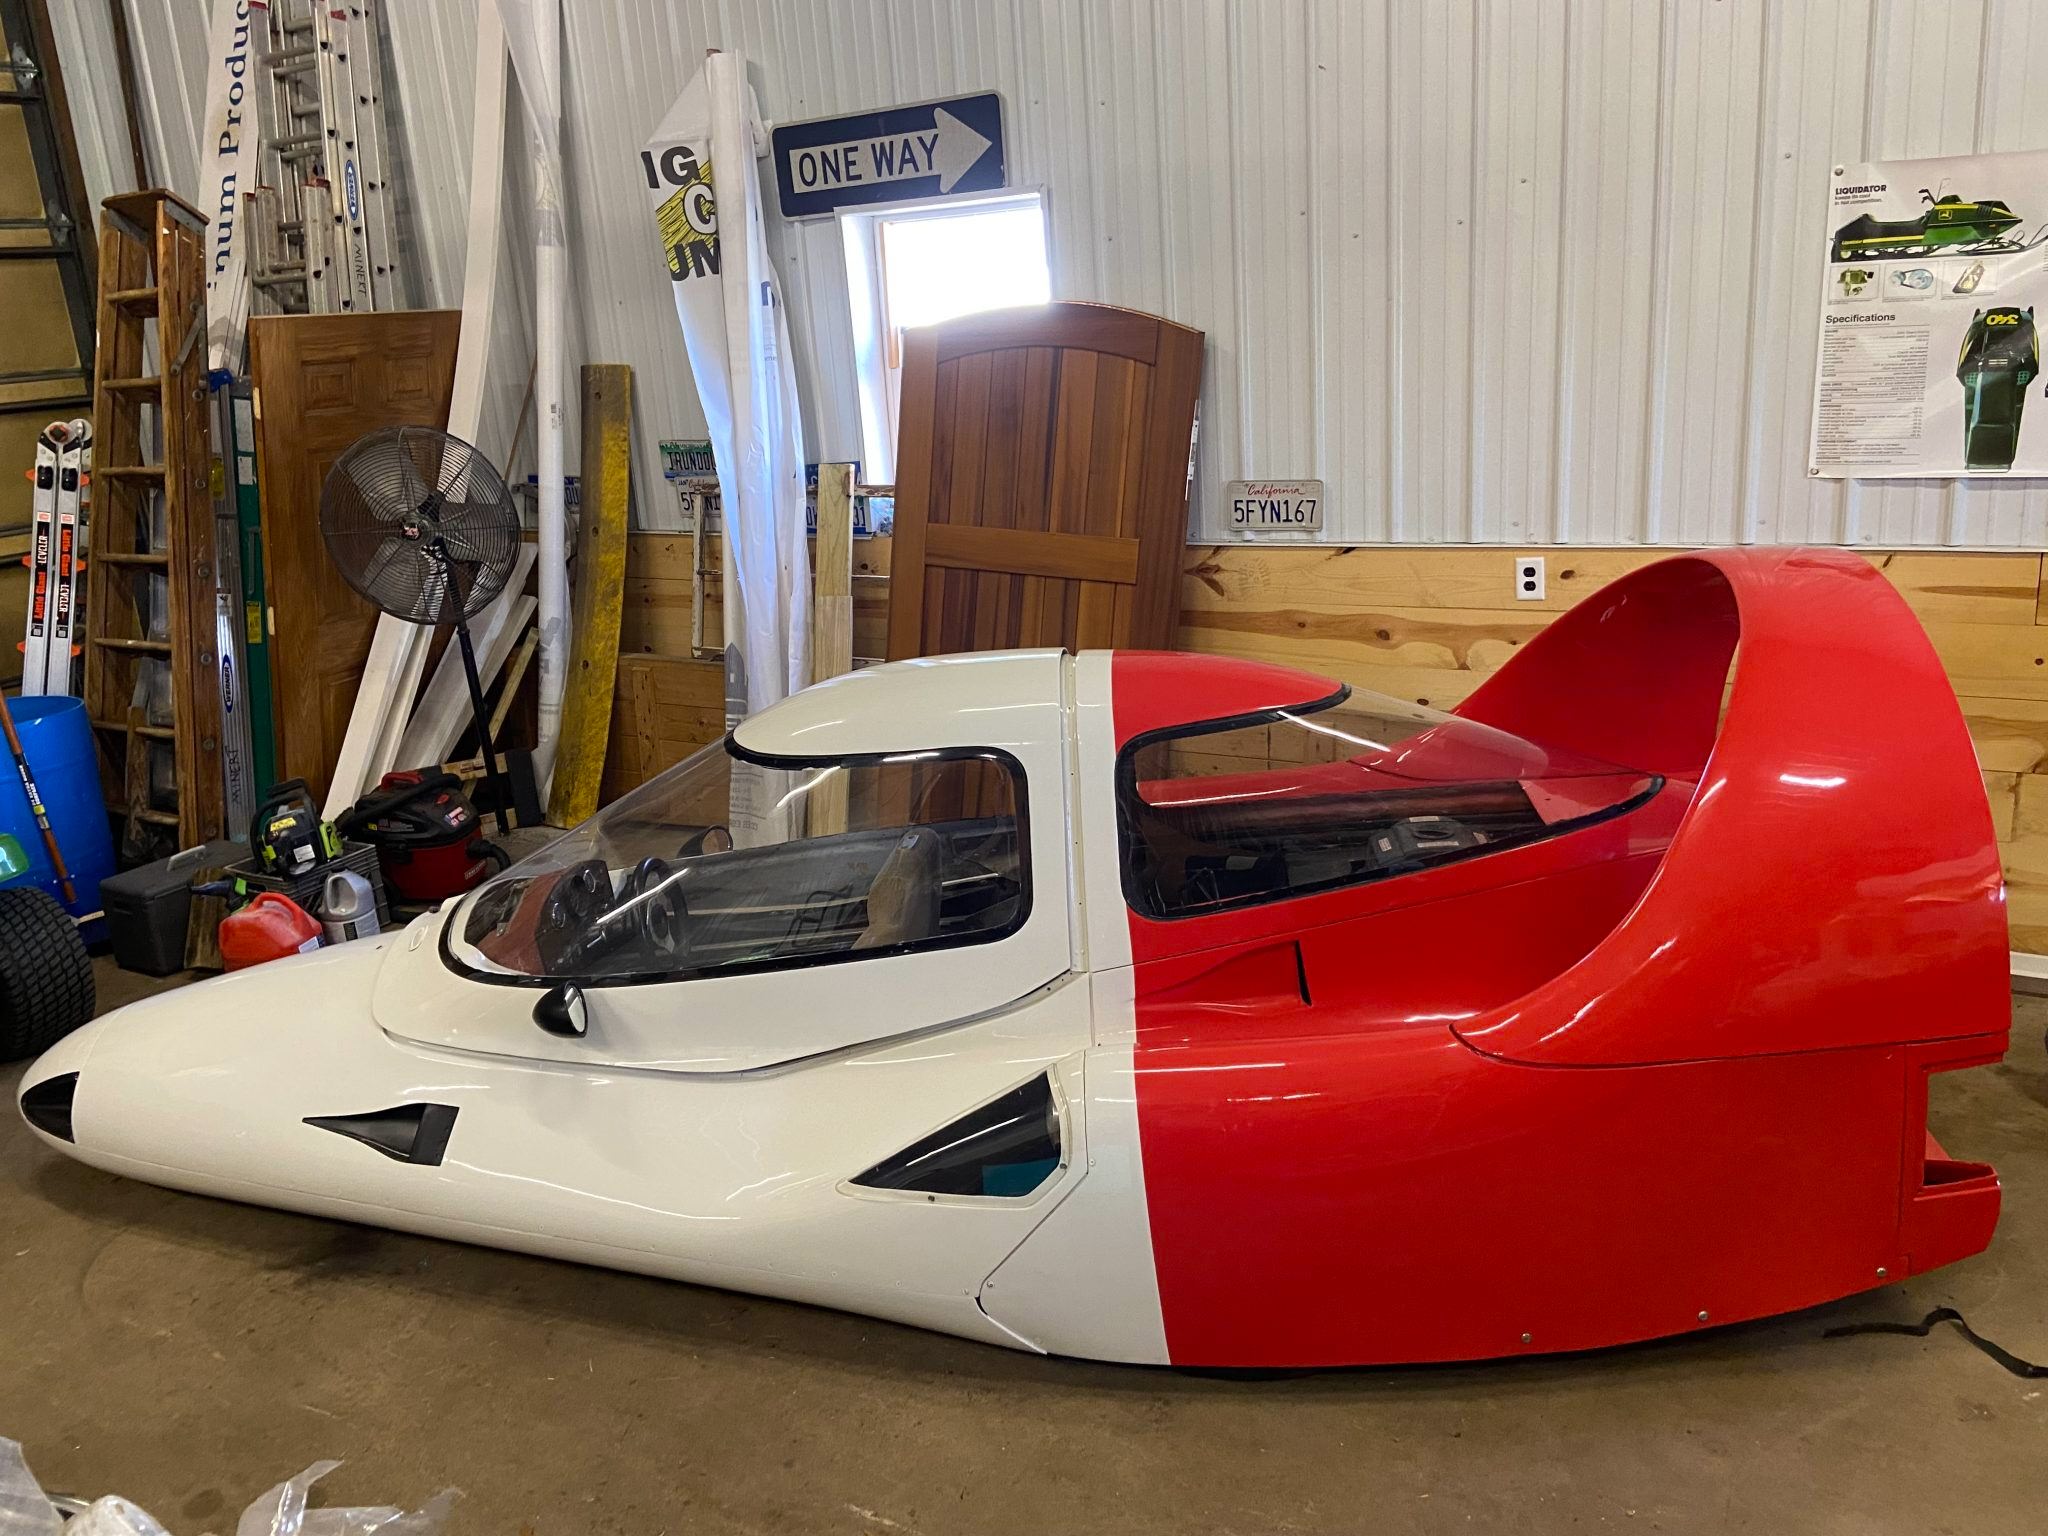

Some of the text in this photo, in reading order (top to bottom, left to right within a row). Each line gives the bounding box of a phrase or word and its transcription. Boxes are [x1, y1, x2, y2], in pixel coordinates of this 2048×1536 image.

[799, 133, 939, 187] ONE WAY
[1835, 184, 1887, 195] LIQUIDATOR
[1826, 314, 1896, 324] Specifications
[1247, 484, 1306, 498] California
[1234, 500, 1317, 524] 5FYN167
[38, 535, 48, 563] LEVELER
[59, 585, 69, 613] LEVELER
[223, 666, 232, 703] WERNER
